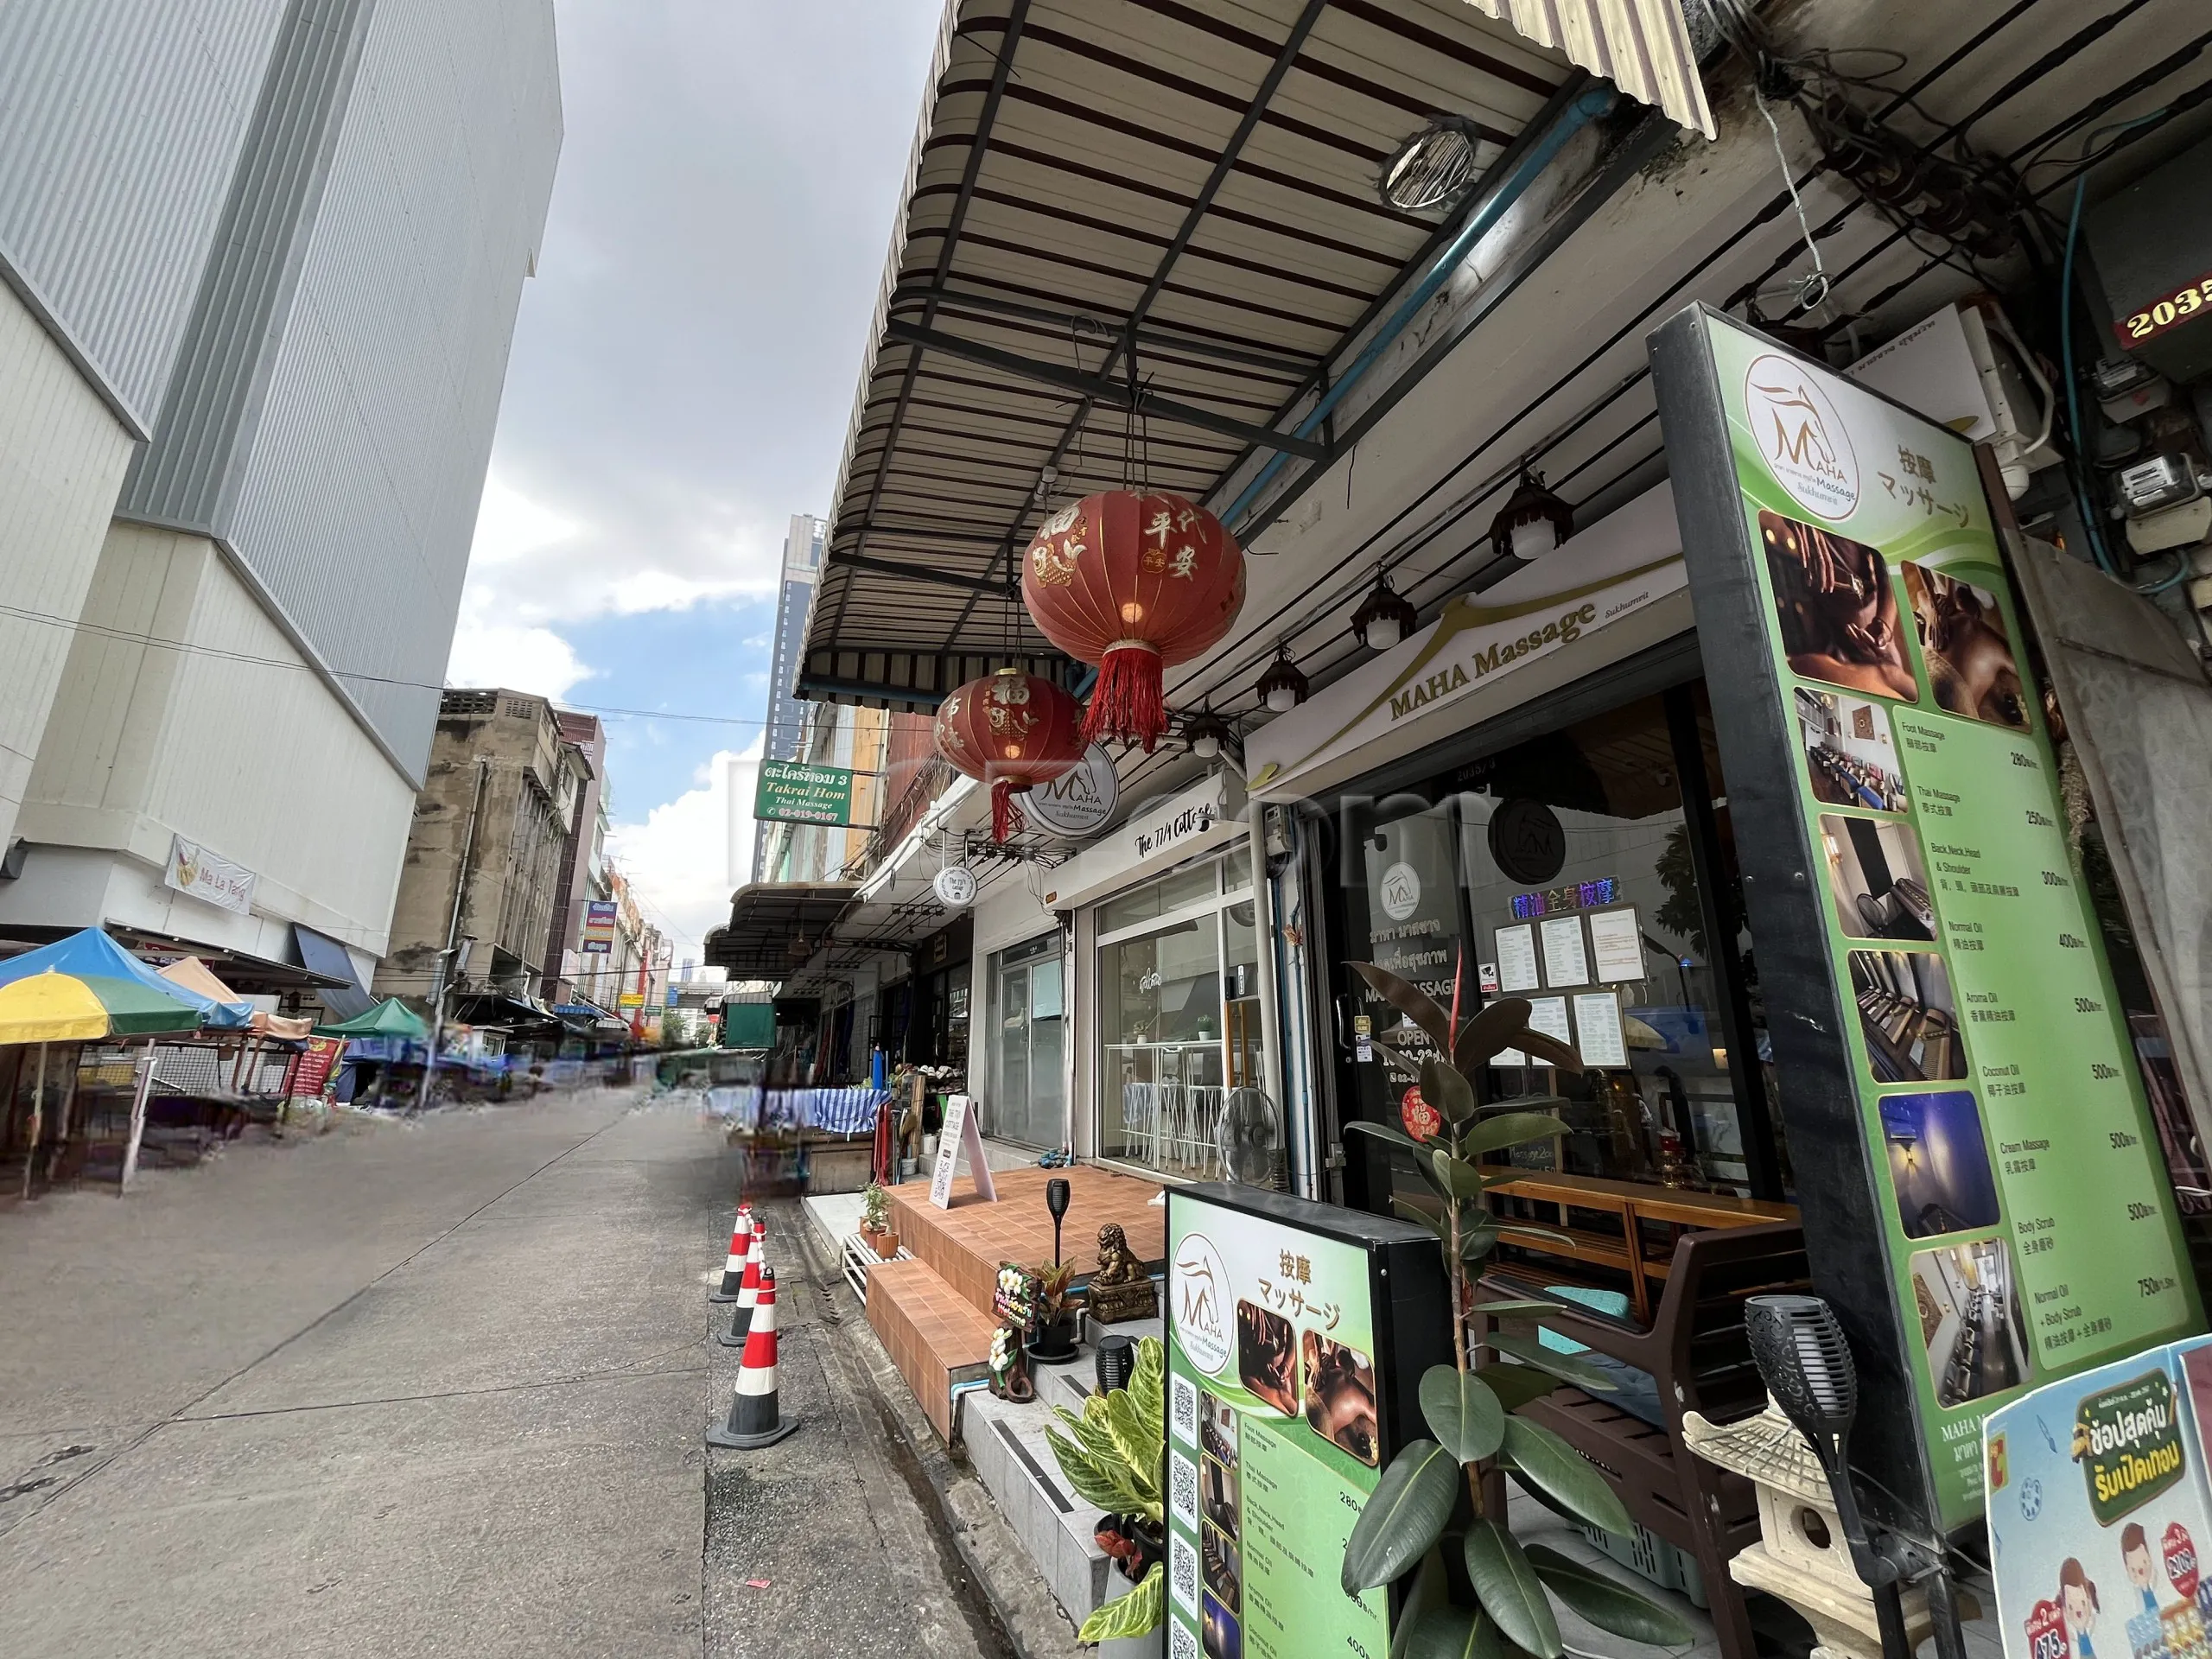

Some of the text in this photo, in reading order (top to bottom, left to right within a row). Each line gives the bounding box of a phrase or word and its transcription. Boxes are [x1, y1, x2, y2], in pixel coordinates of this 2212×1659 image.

[1897, 444, 1936, 484] 按摩
[1817, 477, 1855, 501] Massage
[1878, 471, 1968, 528] マッサージ
[1389, 591, 1649, 721] MAHA Massage Sukhumvit
[1902, 721, 1945, 741] Foot Massage
[766, 781, 845, 800] Takrai Hom
[837, 775, 848, 785] 3
[775, 797, 833, 810] Thai Massage
[1916, 785, 1961, 804] Thai Massage
[1073, 804, 1106, 816] Massage
[1135, 834, 1154, 858] The
[1936, 861, 1971, 874] & Shoulder
[200, 868, 246, 902] Ma La Tang
[1514, 878, 1615, 918] 精油全身按摩
[1948, 920, 1983, 933] Normal Oil
[1966, 992, 1998, 1003] Aroma Oil
[1397, 1029, 1431, 1046] OPEN
[1982, 1064, 2020, 1077] Coconut Oil
[2000, 1139, 2050, 1154] Cream Massage
[2018, 1217, 2055, 1235] Body Scrub
[1280, 1249, 1311, 1285] 按摩
[1258, 1278, 1340, 1331] マッサージ
[2034, 1284, 2069, 1304] Normal Oil
[2045, 1311, 2063, 1326] Body
[2063, 1306, 2082, 1322] Scrub
[1202, 1335, 1227, 1358] Massage
[1244, 1422, 1276, 1448] Foot Massage
[1941, 1418, 1977, 1442] MAHA
[1245, 1460, 1278, 1490] Thai Massage
[1251, 1510, 1274, 1532] Shoulder
[1246, 1540, 1273, 1567] Normal Oil
[1248, 1582, 1273, 1609] Aroma Oil
[1249, 1624, 1269, 1649] Coconut
